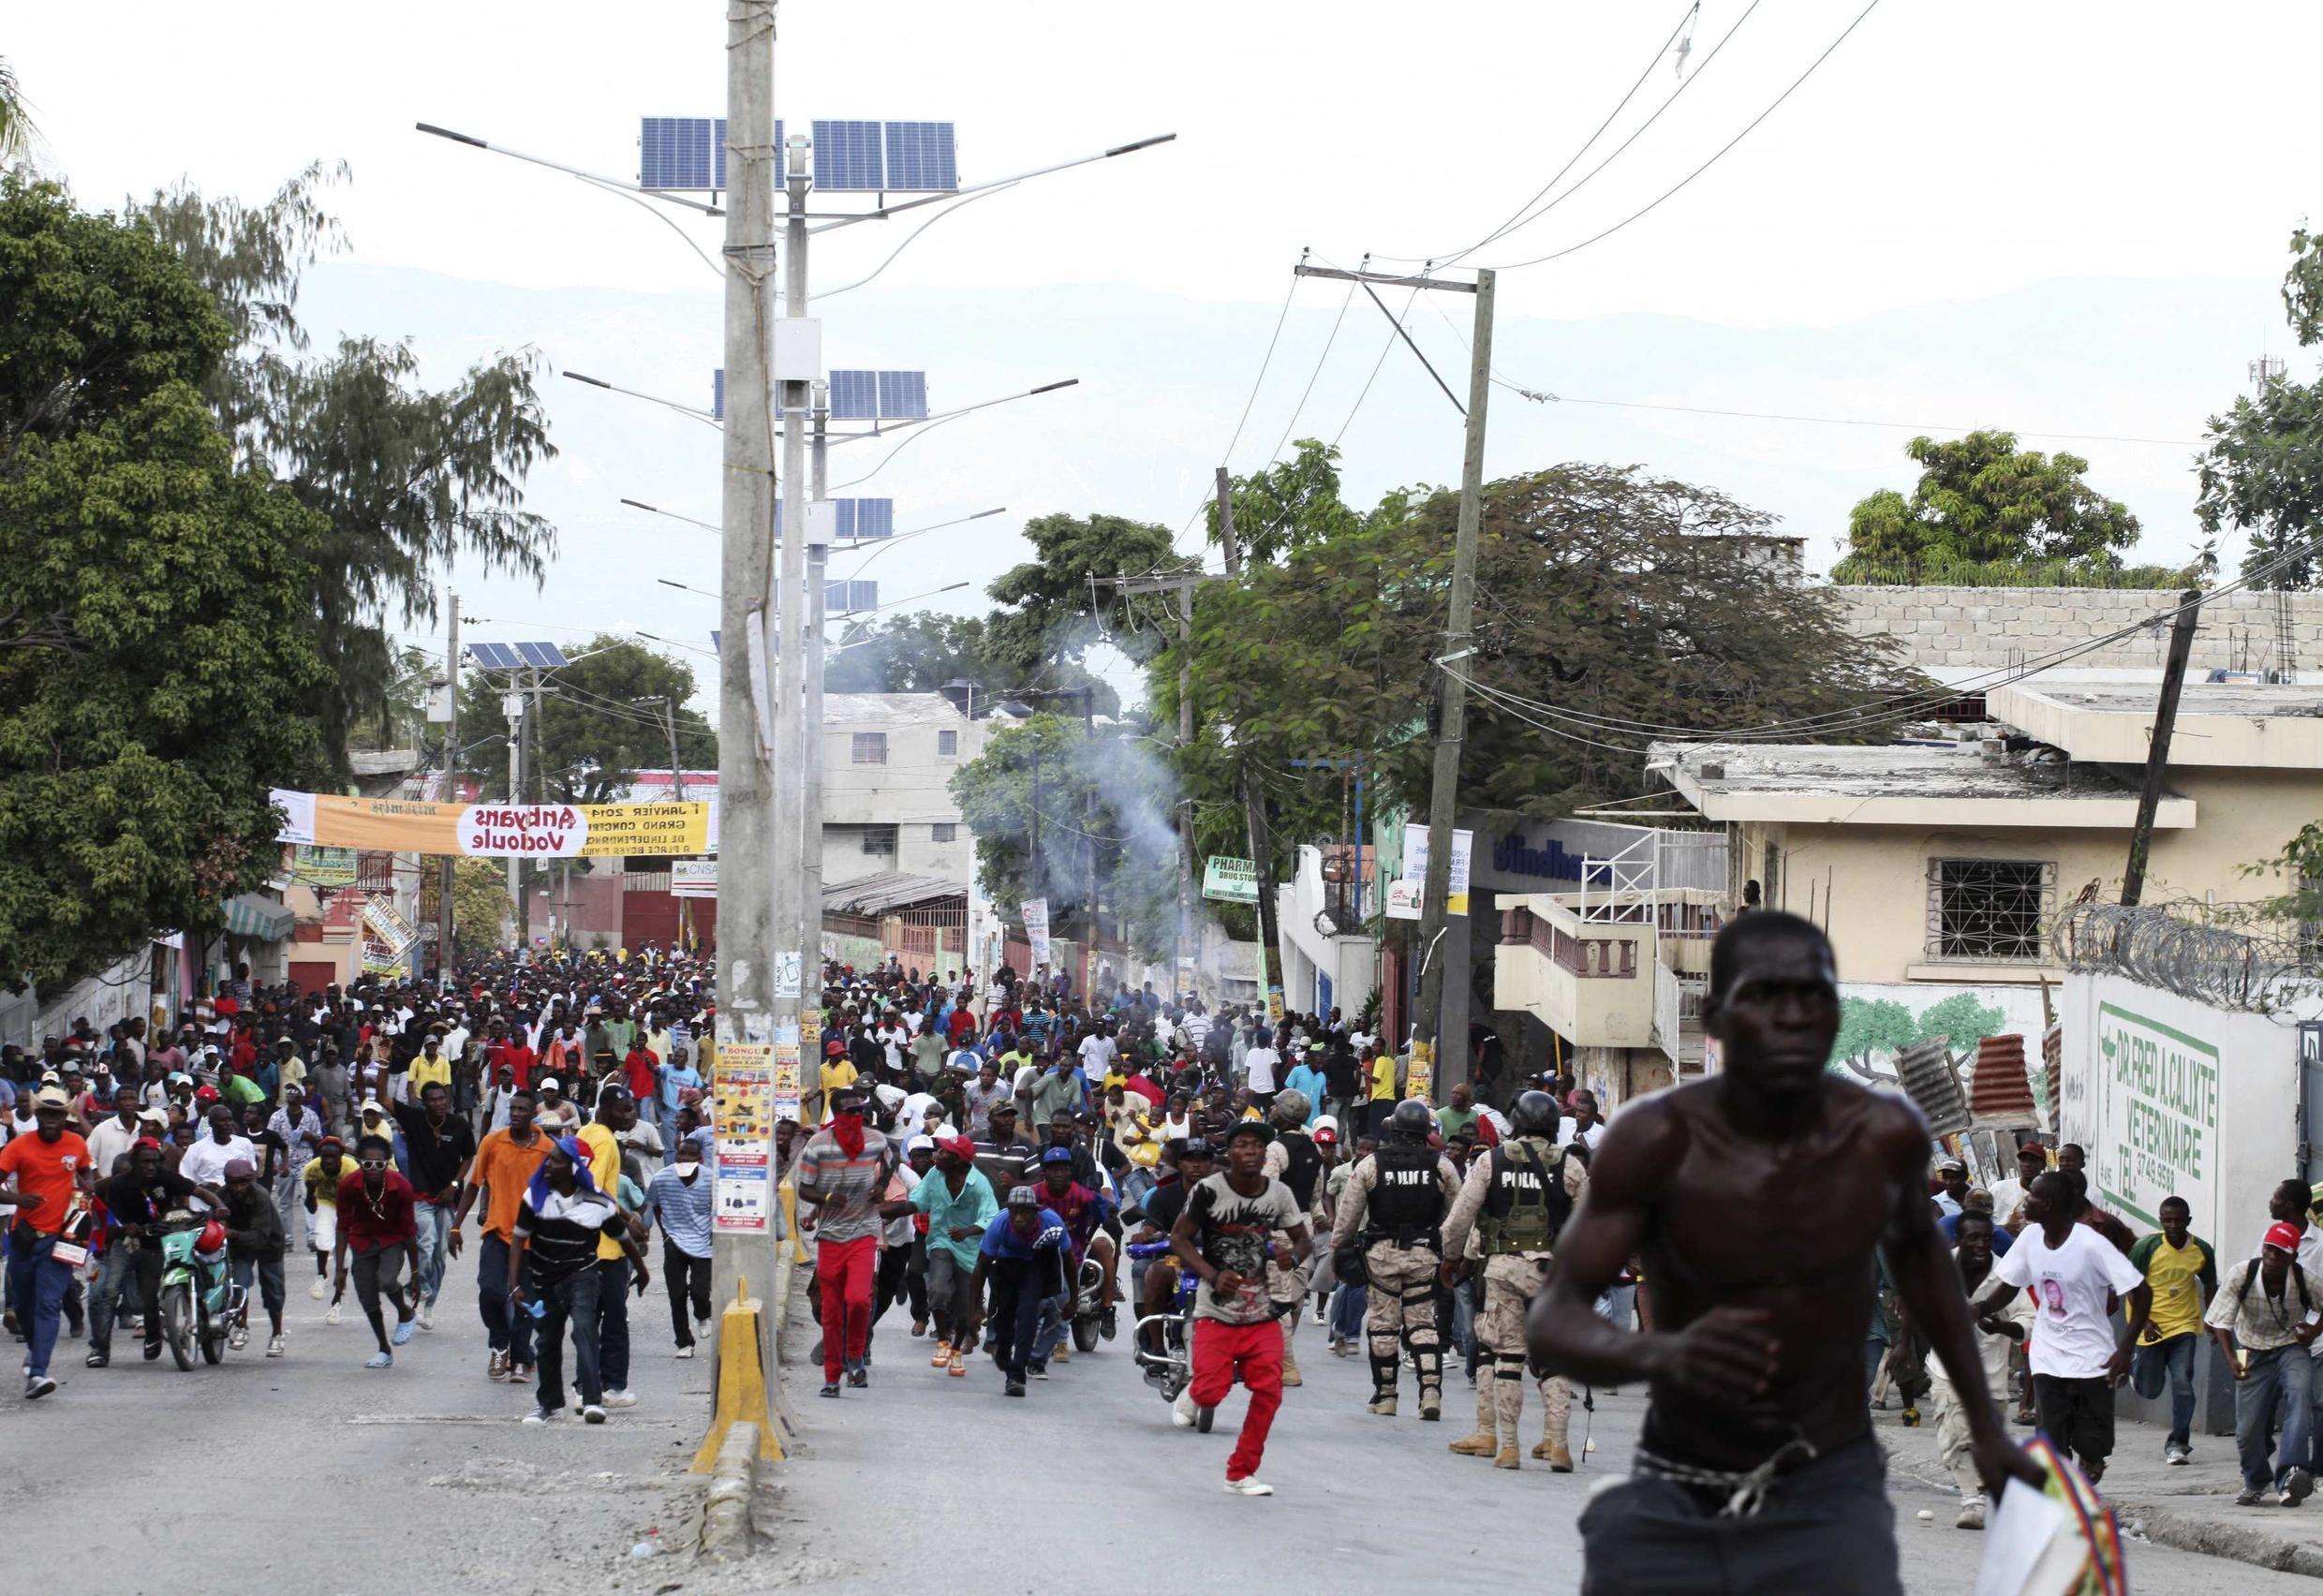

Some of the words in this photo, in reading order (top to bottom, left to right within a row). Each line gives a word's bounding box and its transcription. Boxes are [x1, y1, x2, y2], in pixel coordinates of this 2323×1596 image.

[1219, 872, 1238, 881] DRUG
[1238, 874, 1258, 882] STOR
[2126, 1095, 2202, 1181] VETERINAIRE
